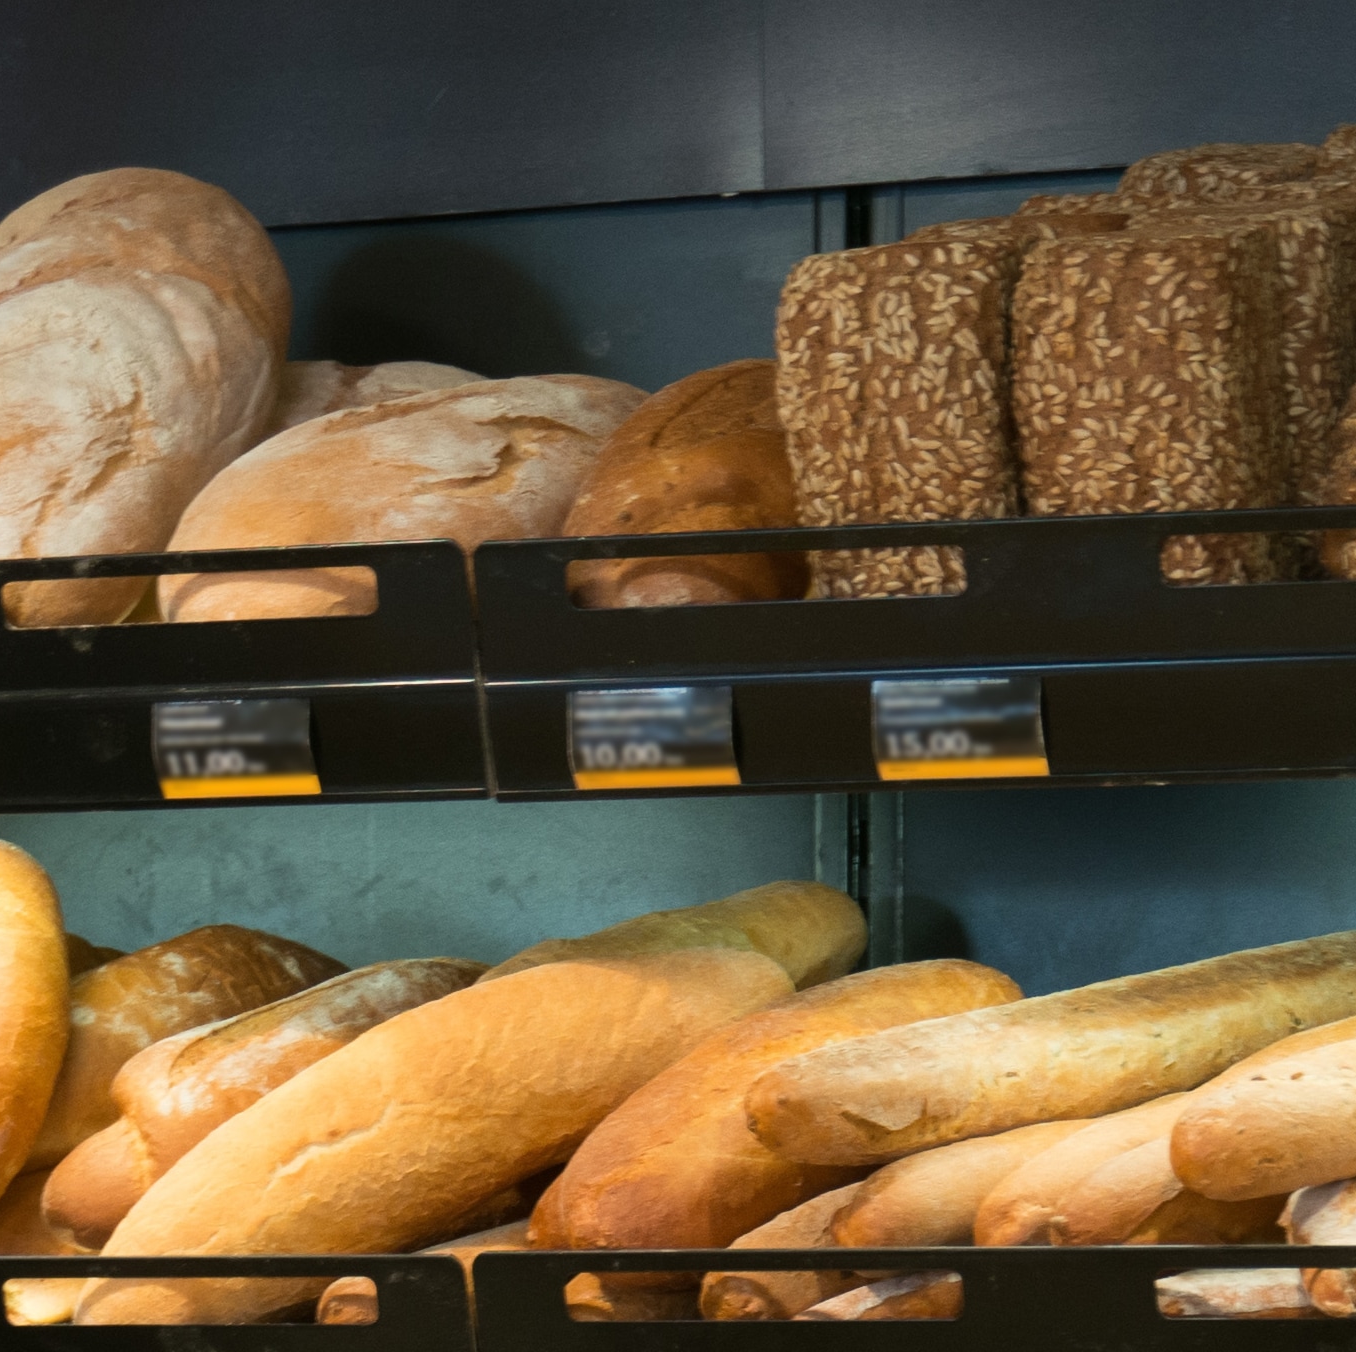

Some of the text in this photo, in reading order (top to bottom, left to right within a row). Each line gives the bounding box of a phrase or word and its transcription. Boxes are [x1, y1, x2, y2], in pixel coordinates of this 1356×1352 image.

[580, 742, 662, 769] 10,00
[883, 731, 971, 759] 15,00
[165, 750, 245, 776] 11,00
